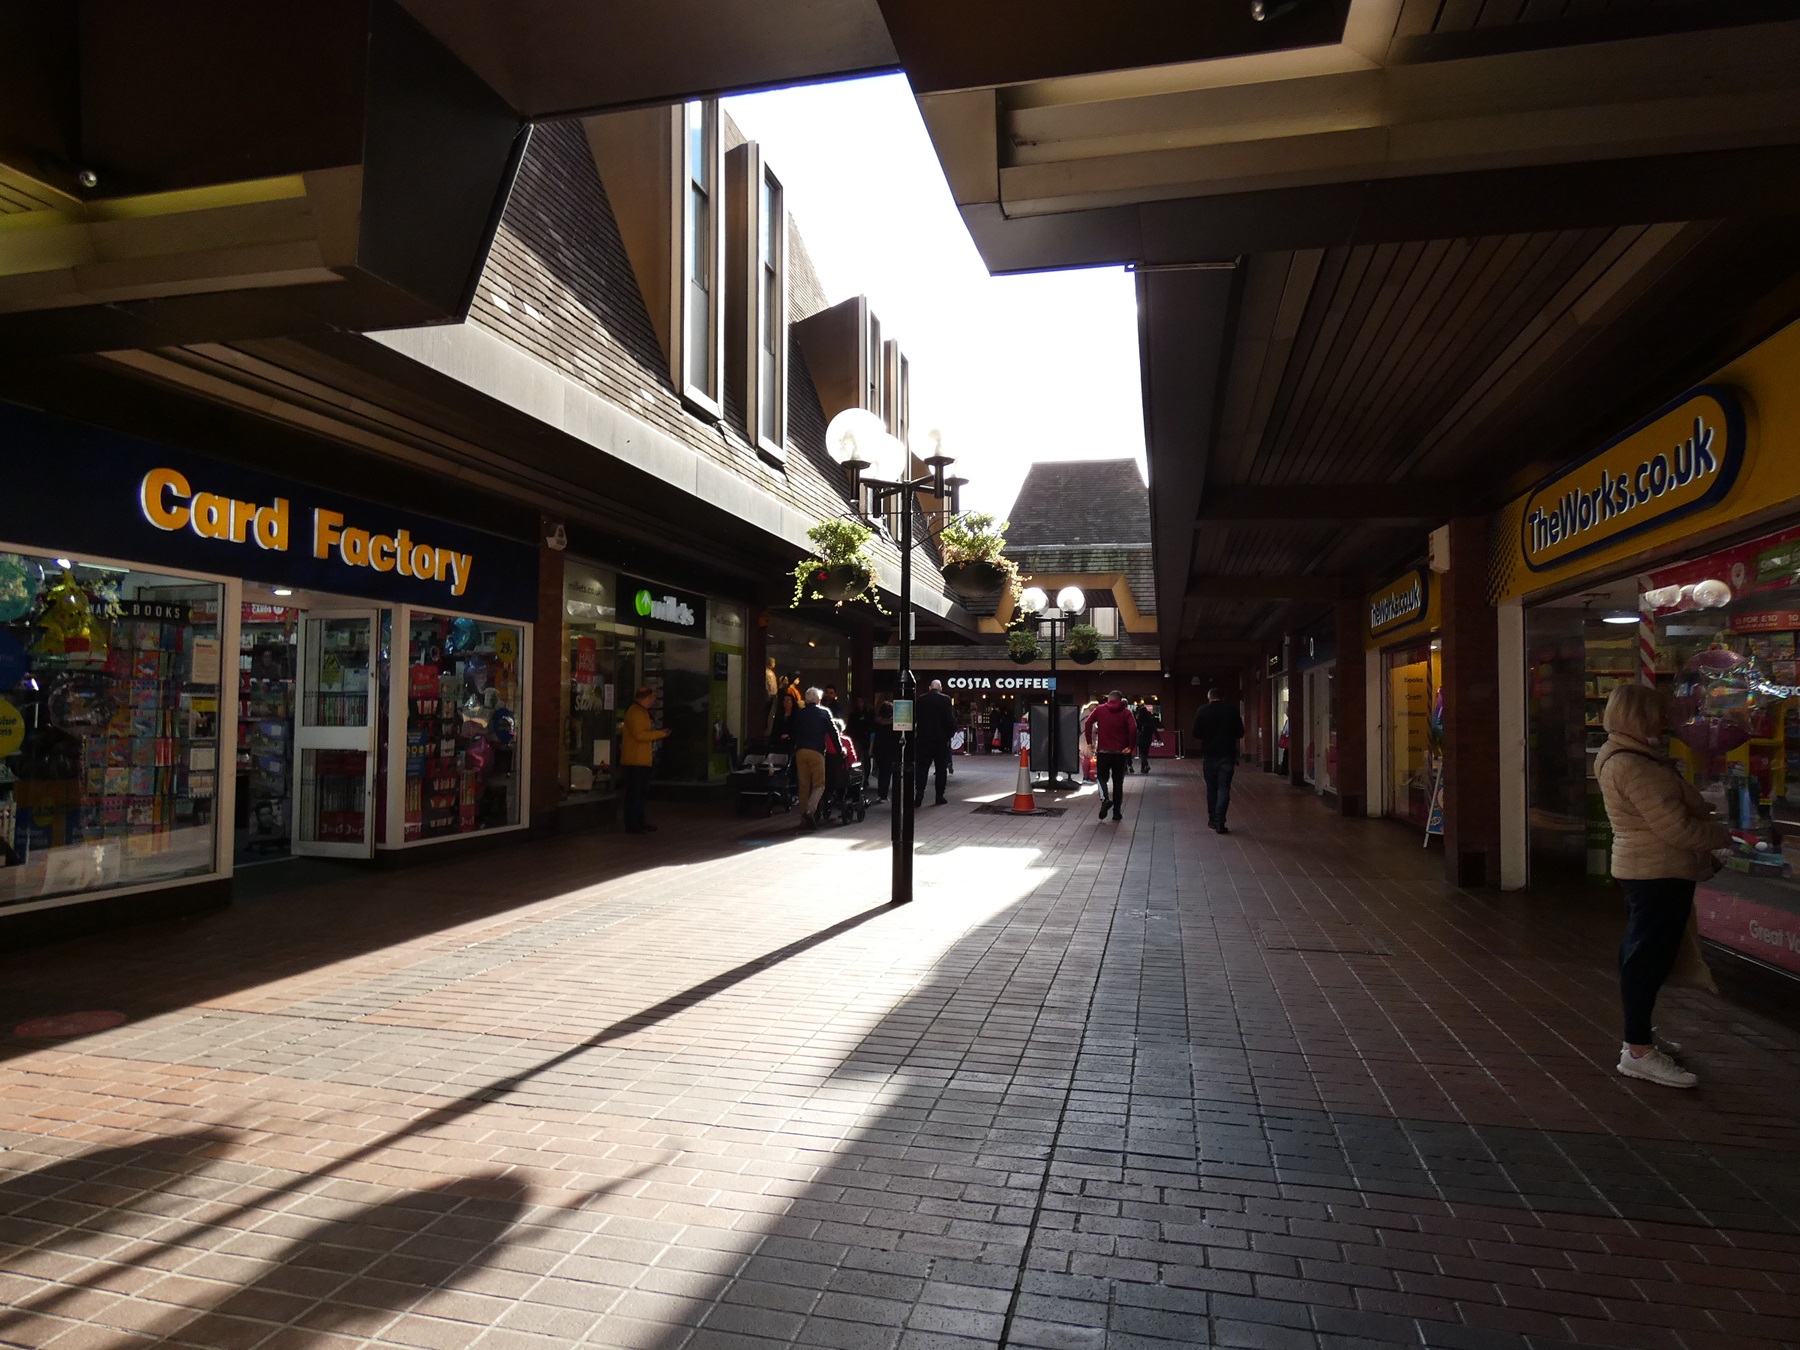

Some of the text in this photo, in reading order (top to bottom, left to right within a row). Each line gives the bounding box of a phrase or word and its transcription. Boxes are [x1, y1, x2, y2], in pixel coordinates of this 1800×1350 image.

[1528, 415, 1718, 554] TheWorks.co.uk
[140, 466, 474, 597] Card Factory
[132, 603, 181, 619] BOOKS
[1369, 580, 1421, 629] TheWorks.co.uk
[947, 676, 1049, 690] COSTA COFFEE
[1749, 918, 1784, 947] Great
